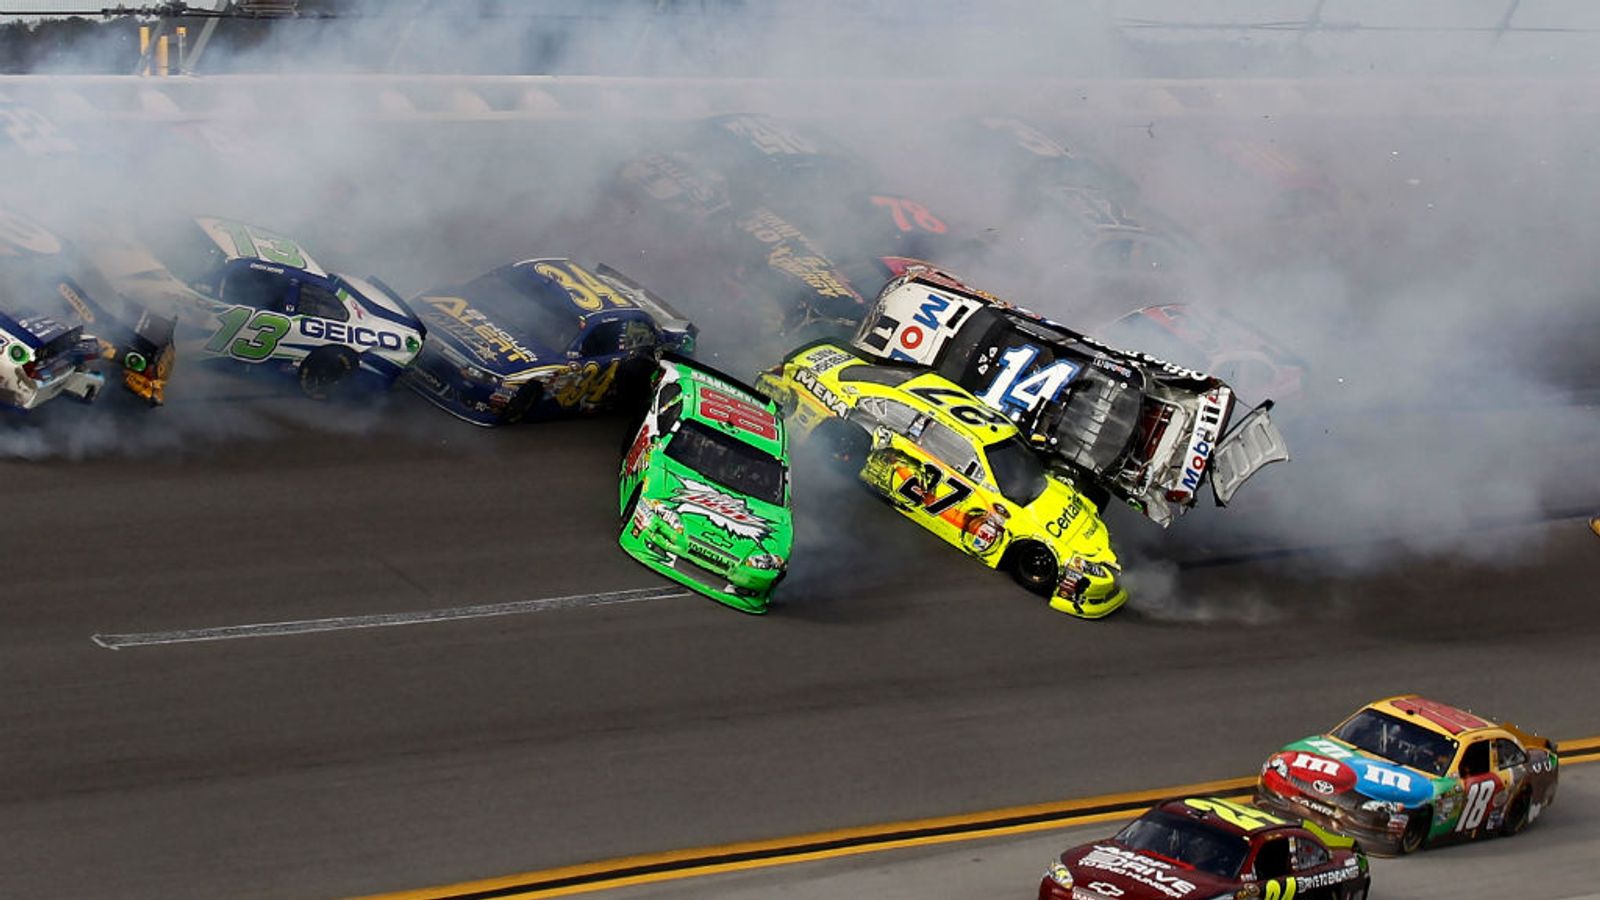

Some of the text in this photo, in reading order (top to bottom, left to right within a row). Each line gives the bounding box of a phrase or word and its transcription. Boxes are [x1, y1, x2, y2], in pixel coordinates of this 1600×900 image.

[869, 195, 947, 233] 78
[219, 219, 307, 269] 13
[534, 262, 634, 312] 34
[206, 307, 293, 363] 13
[300, 317, 402, 352] GEICO
[974, 344, 1081, 416] 14
[899, 460, 974, 516] 27
[1292, 753, 1341, 777] m
[1364, 763, 1412, 792] m
[1184, 797, 1287, 831] 24
[1454, 779, 1496, 833] 18
[1078, 850, 1197, 896] DRIVE
